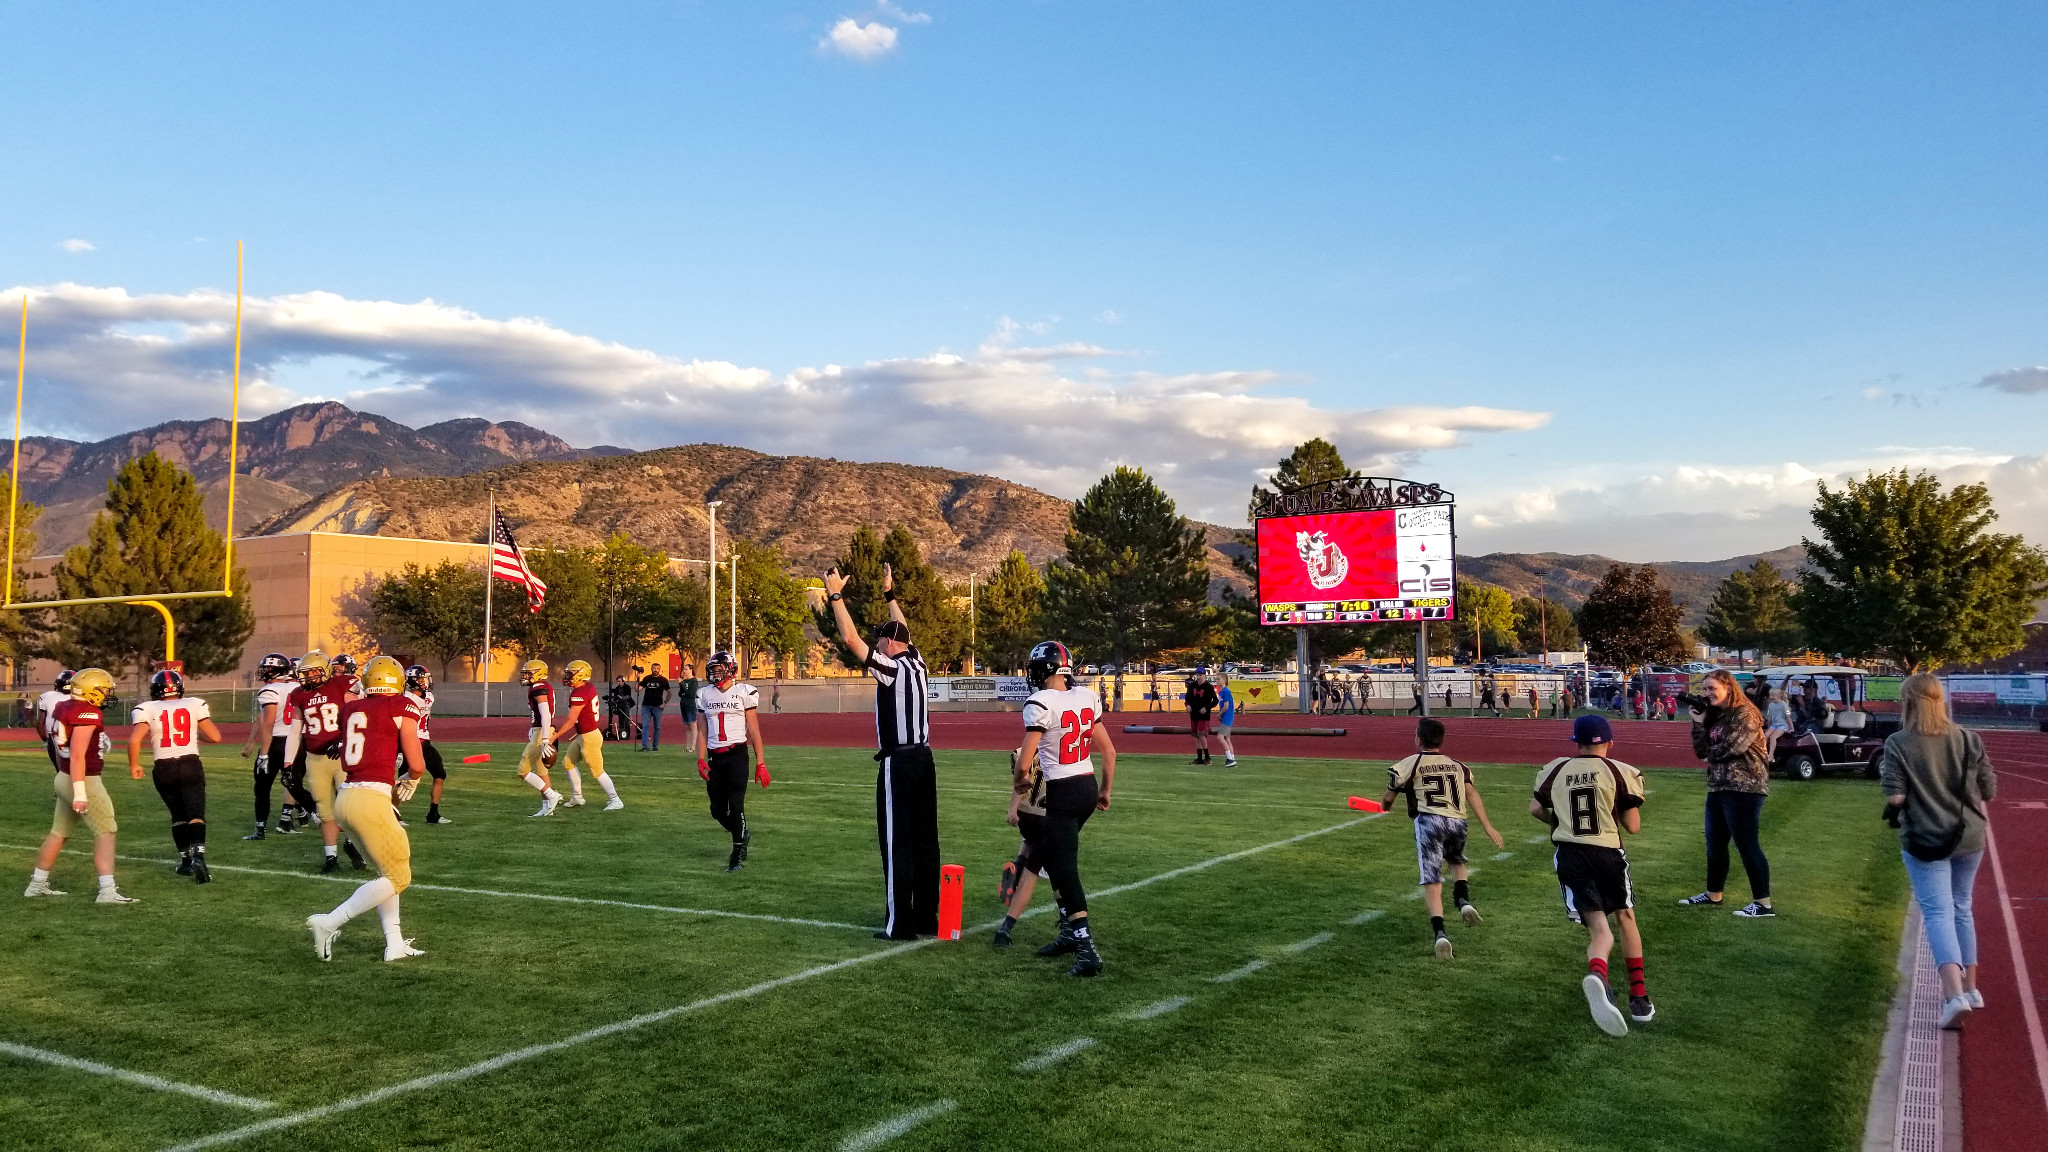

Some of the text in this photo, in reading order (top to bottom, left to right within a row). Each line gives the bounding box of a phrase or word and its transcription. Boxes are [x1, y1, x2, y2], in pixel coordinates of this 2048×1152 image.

[1267, 483, 1442, 516] JUAB WASPS
[1400, 577, 1451, 593] CIS
[1265, 603, 1297, 613] WASPS
[1412, 598, 1448, 607] TIGERS
[1275, 613, 1281, 622] 7
[1325, 611, 1333, 620] 2
[1359, 613, 1365, 621] 2
[1385, 609, 1400, 618] 12
[1431, 607, 1439, 618] 7
[307, 695, 328, 706] JUAB
[706, 702, 740, 710] HURRICANE
[303, 702, 339, 735] 58
[159, 707, 191, 747] 19
[717, 711, 728, 741] 1
[344, 711, 368, 767] 6
[1058, 707, 1095, 764] 22
[1566, 772, 1599, 786] PARK
[1422, 773, 1461, 811] 21
[1569, 785, 1601, 837] 8
